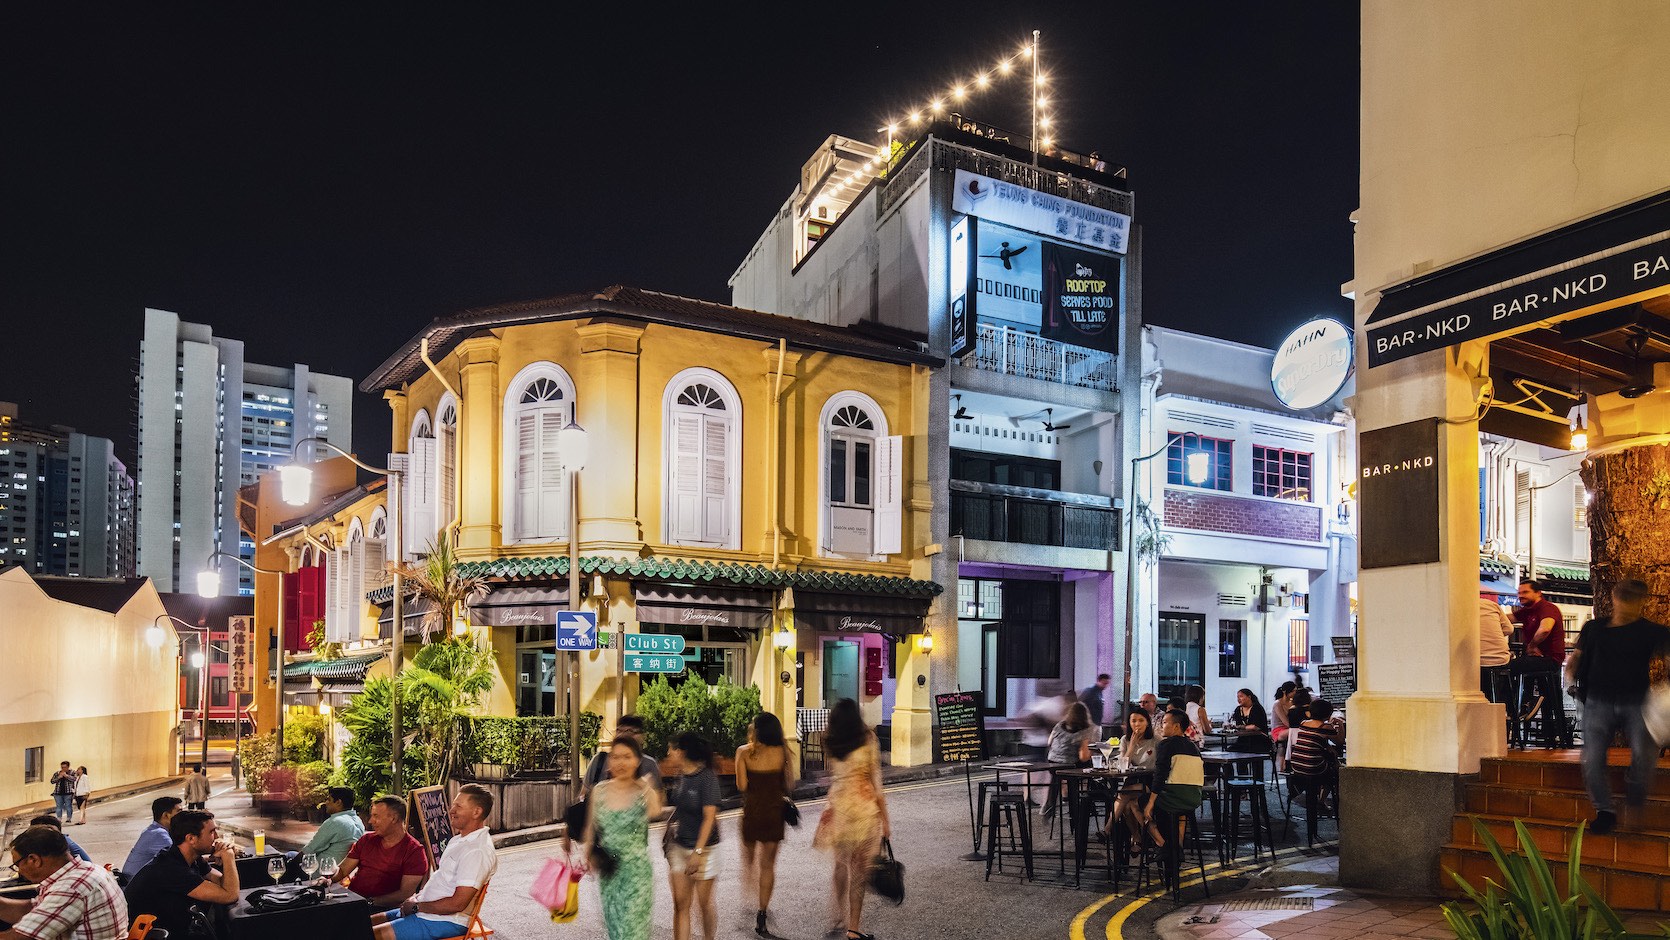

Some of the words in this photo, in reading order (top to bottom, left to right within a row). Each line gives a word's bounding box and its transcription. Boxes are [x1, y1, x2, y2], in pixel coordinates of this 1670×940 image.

[1065, 203, 1123, 229] FOUNDATION
[1066, 279, 1106, 293] ROOFTOP
[1061, 295, 1091, 307] SERVES
[1092, 296, 1113, 308] FOOD
[1070, 310, 1086, 322] TILL
[1087, 310, 1106, 322] LATE
[1285, 327, 1327, 357] HAHN
[500, 607, 545, 624] Beaujolais
[679, 608, 730, 625] Beaujolais
[837, 616, 882, 631] Beaujolais
[560, 637, 576, 646] ONE
[578, 638, 593, 646] WAY
[628, 637, 658, 649] Club
[663, 638, 677, 650] St
